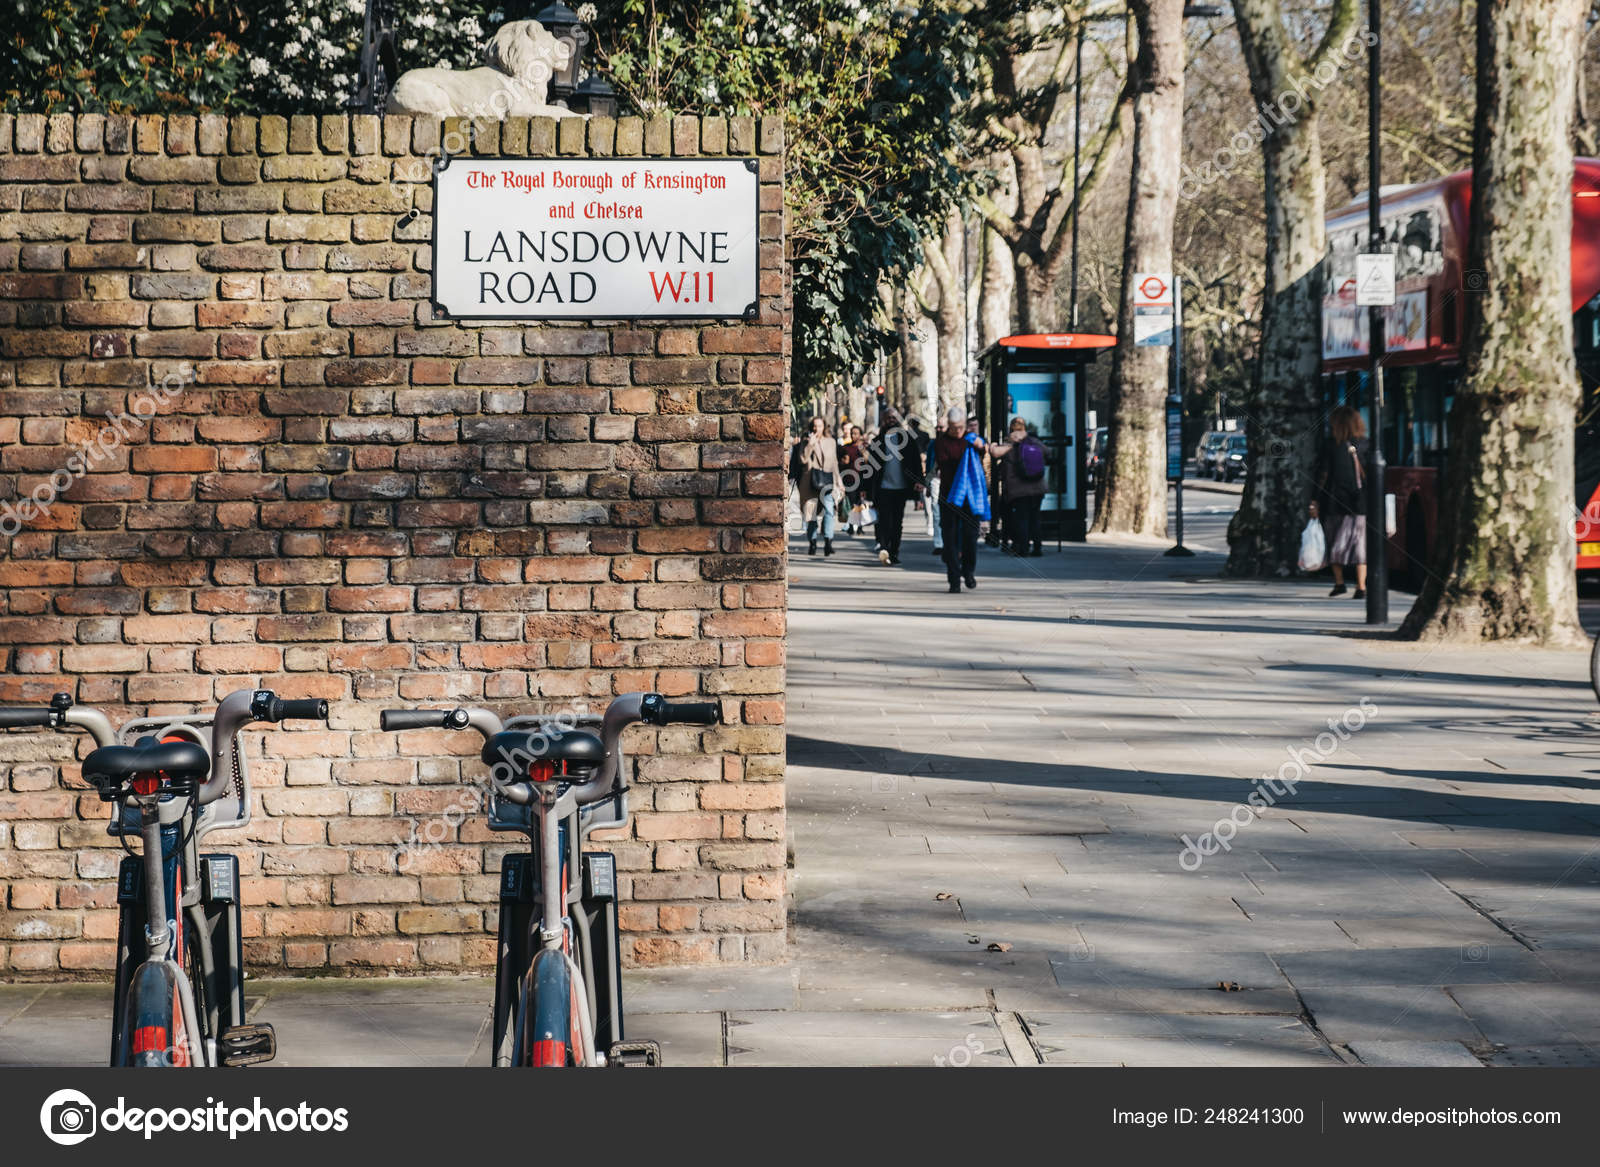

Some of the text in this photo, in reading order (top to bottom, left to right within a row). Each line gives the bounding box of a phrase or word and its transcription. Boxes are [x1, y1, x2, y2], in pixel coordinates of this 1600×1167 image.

[466, 170, 726, 194] The Royal Borough of Kensington
[549, 200, 643, 219] and Chelsea
[463, 230, 730, 264] LANSDOWNE
[479, 271, 714, 304] ROAD W.11
